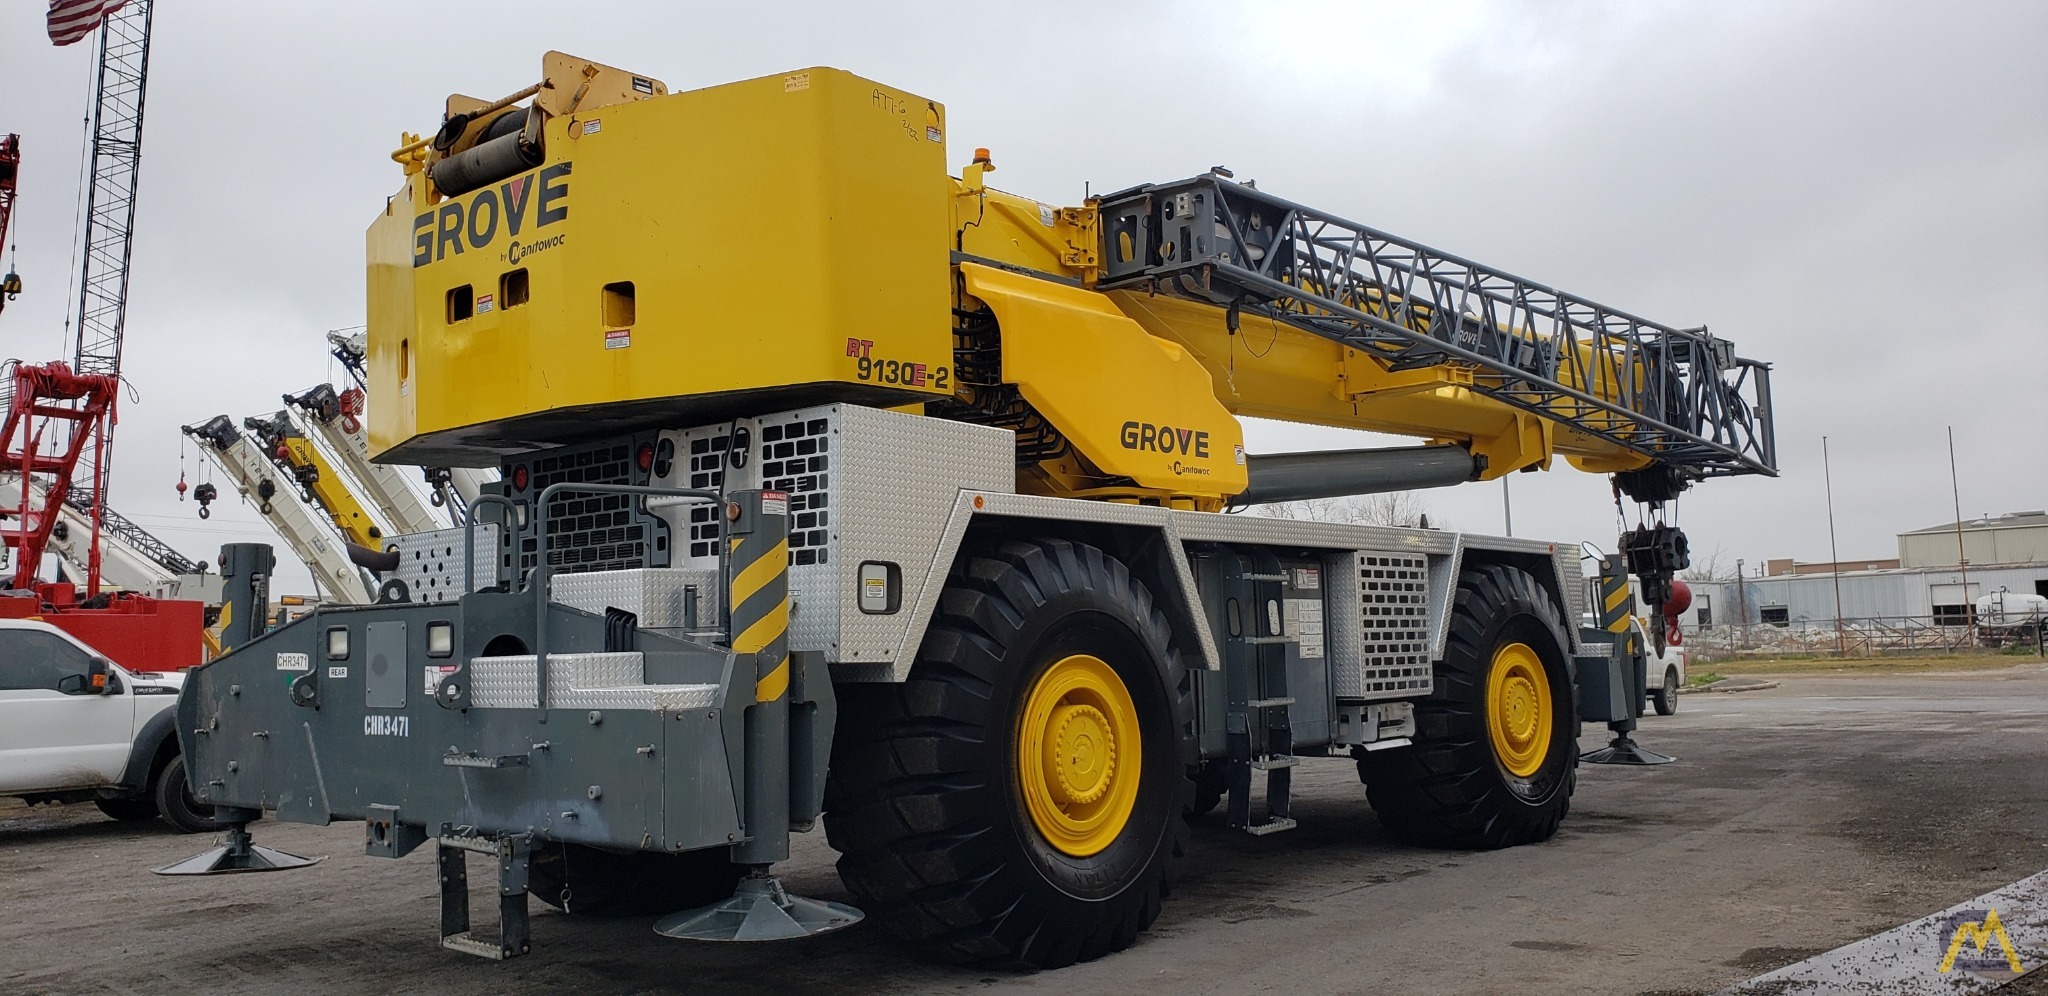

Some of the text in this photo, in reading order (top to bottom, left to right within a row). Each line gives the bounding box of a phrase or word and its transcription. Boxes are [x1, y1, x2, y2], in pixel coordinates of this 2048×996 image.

[412, 161, 573, 268] GROVE
[508, 234, 565, 265] Manitowoc
[846, 337, 873, 358] RT
[1455, 329, 1478, 345] ROVE
[857, 356, 949, 389] 9130E-2
[1120, 421, 1209, 458] GROVE
[1173, 460, 1210, 476] Manitowoc
[277, 655, 308, 668] CHR3471
[330, 668, 346, 677] REAR
[364, 715, 409, 737] CHR3471
